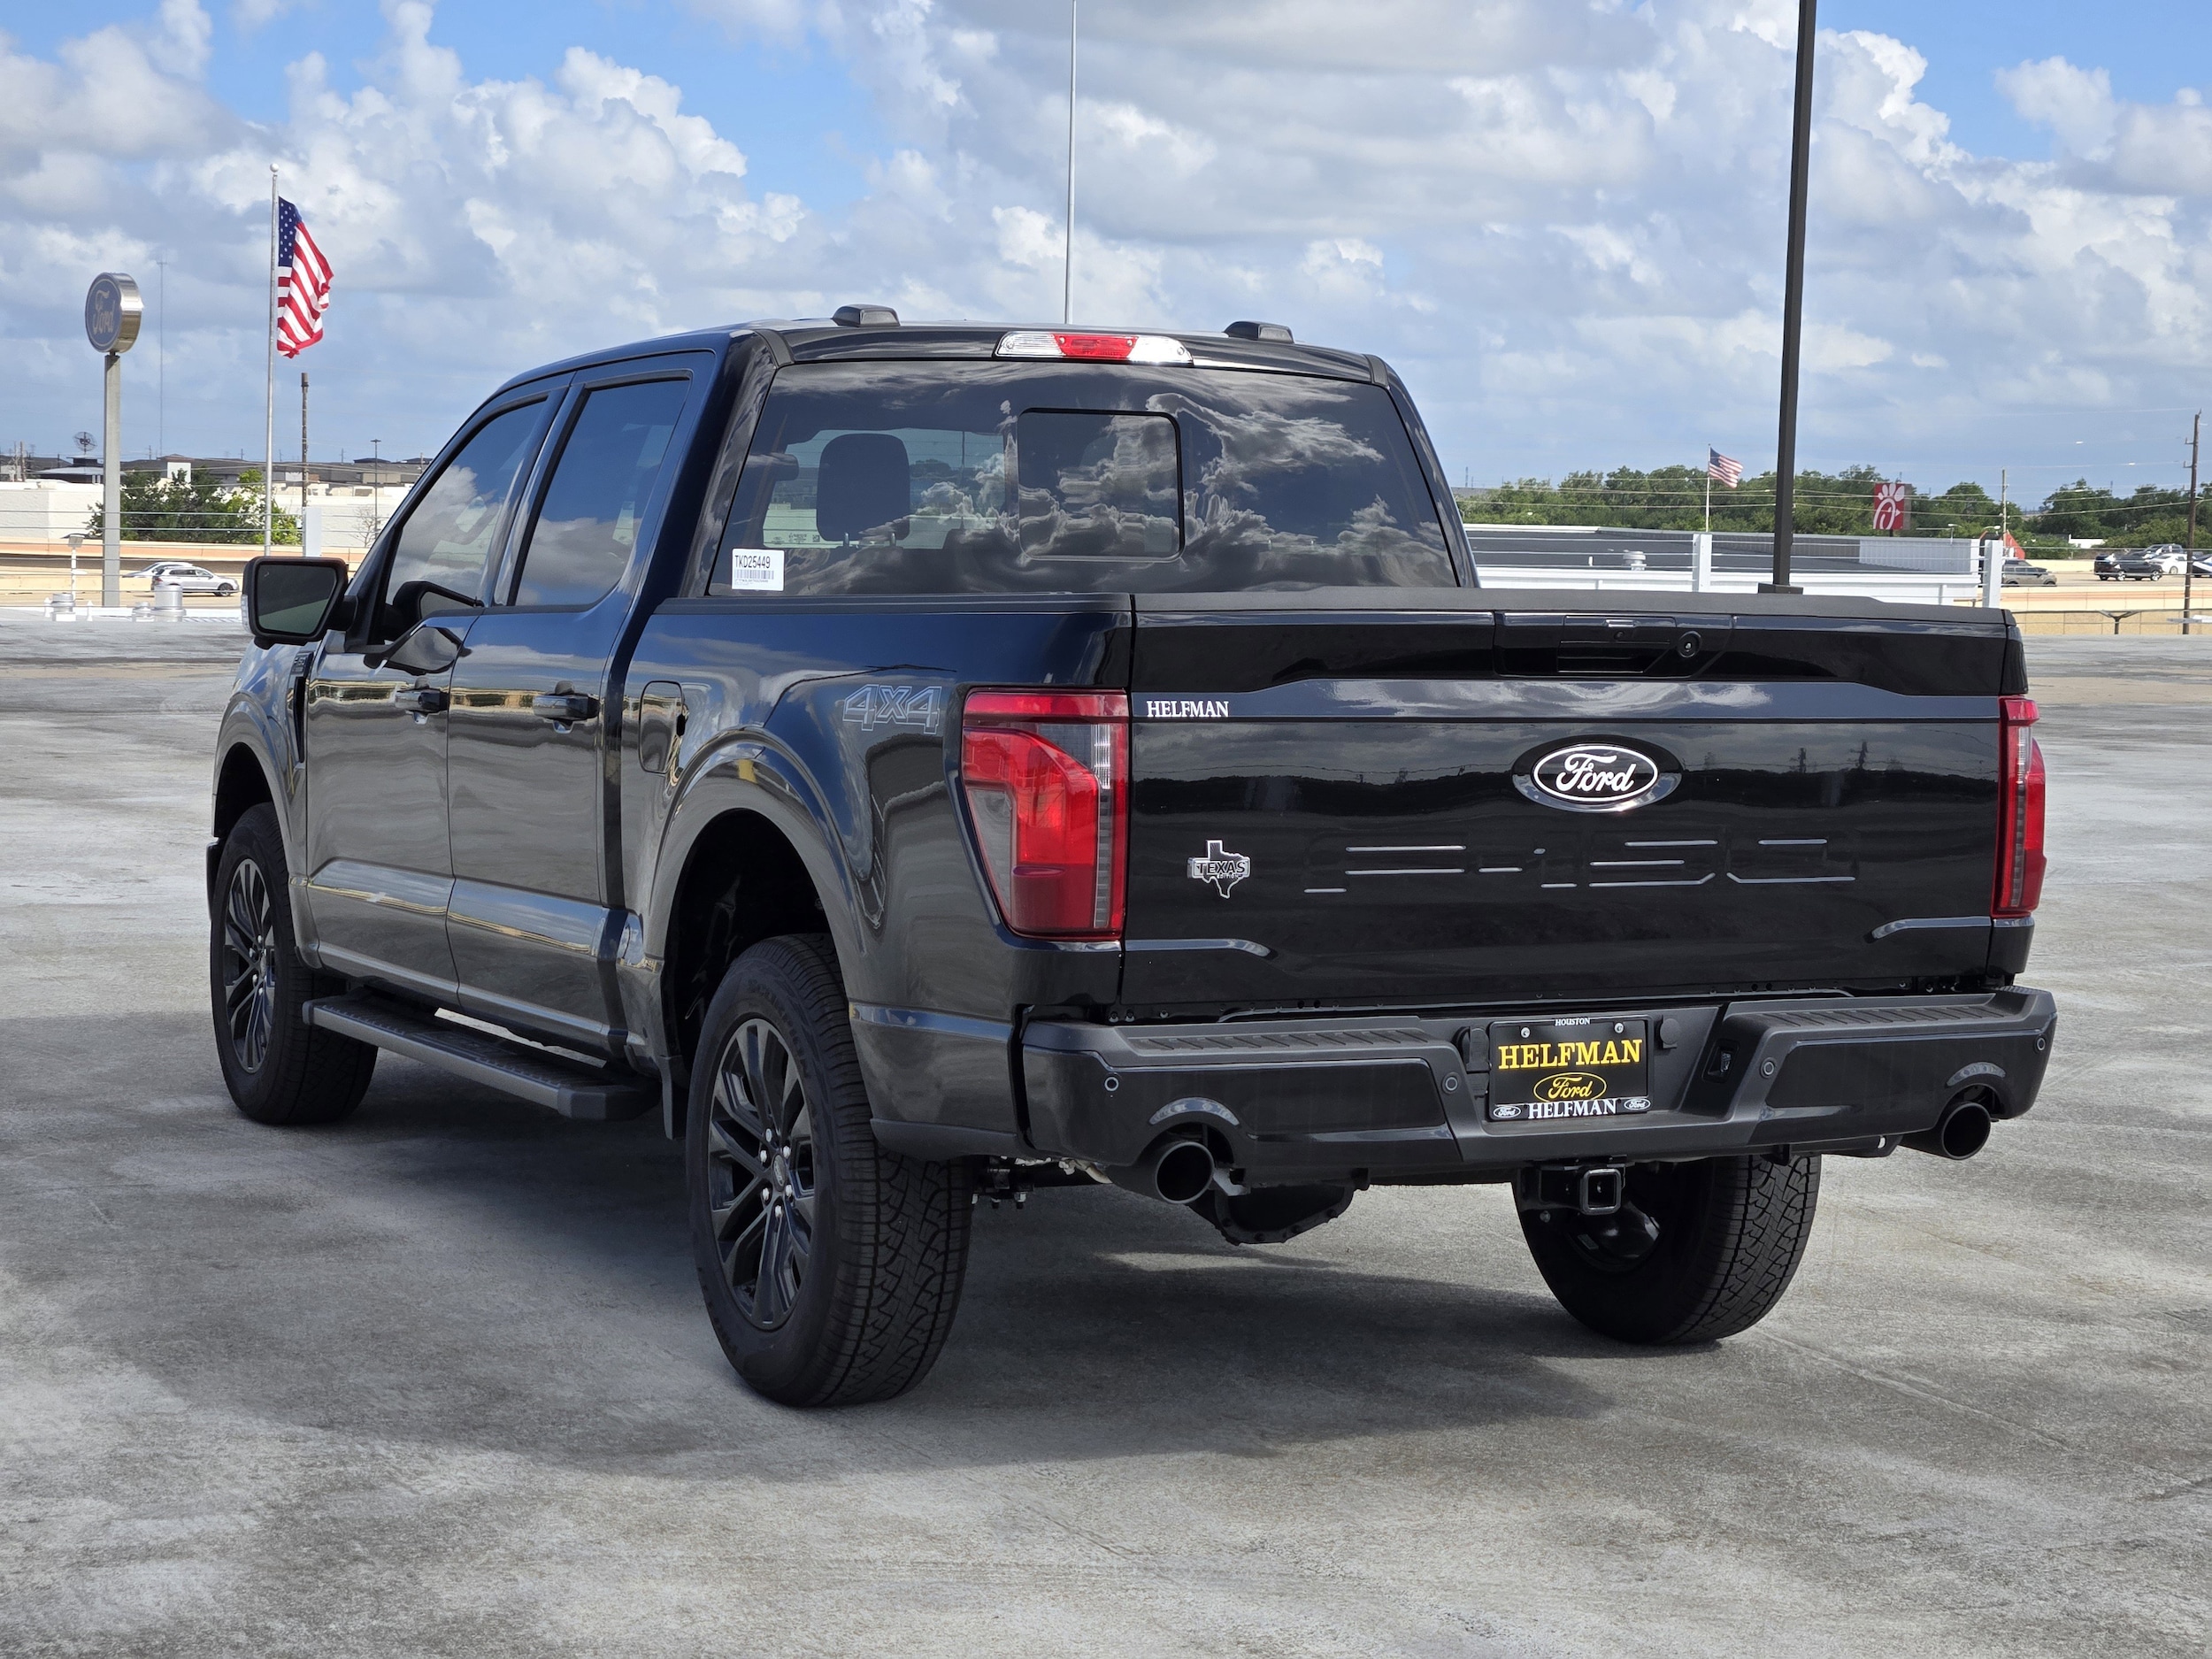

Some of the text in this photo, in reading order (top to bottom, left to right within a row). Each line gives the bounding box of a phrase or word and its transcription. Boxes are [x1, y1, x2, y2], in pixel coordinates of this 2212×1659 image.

[93, 289, 116, 335] Ford
[734, 555, 771, 569] TKD25449
[842, 684, 942, 734] 4X4
[1146, 700, 1229, 718] HELFMAN
[1555, 753, 1637, 792] Ford
[1194, 861, 1247, 874] TEXAS
[1555, 1018, 1591, 1026] HOUSTON
[1498, 1039, 1643, 1070] HELFMAN
[1548, 1076, 1593, 1099] Ford
[1528, 1098, 1617, 1119] HELFMAN
